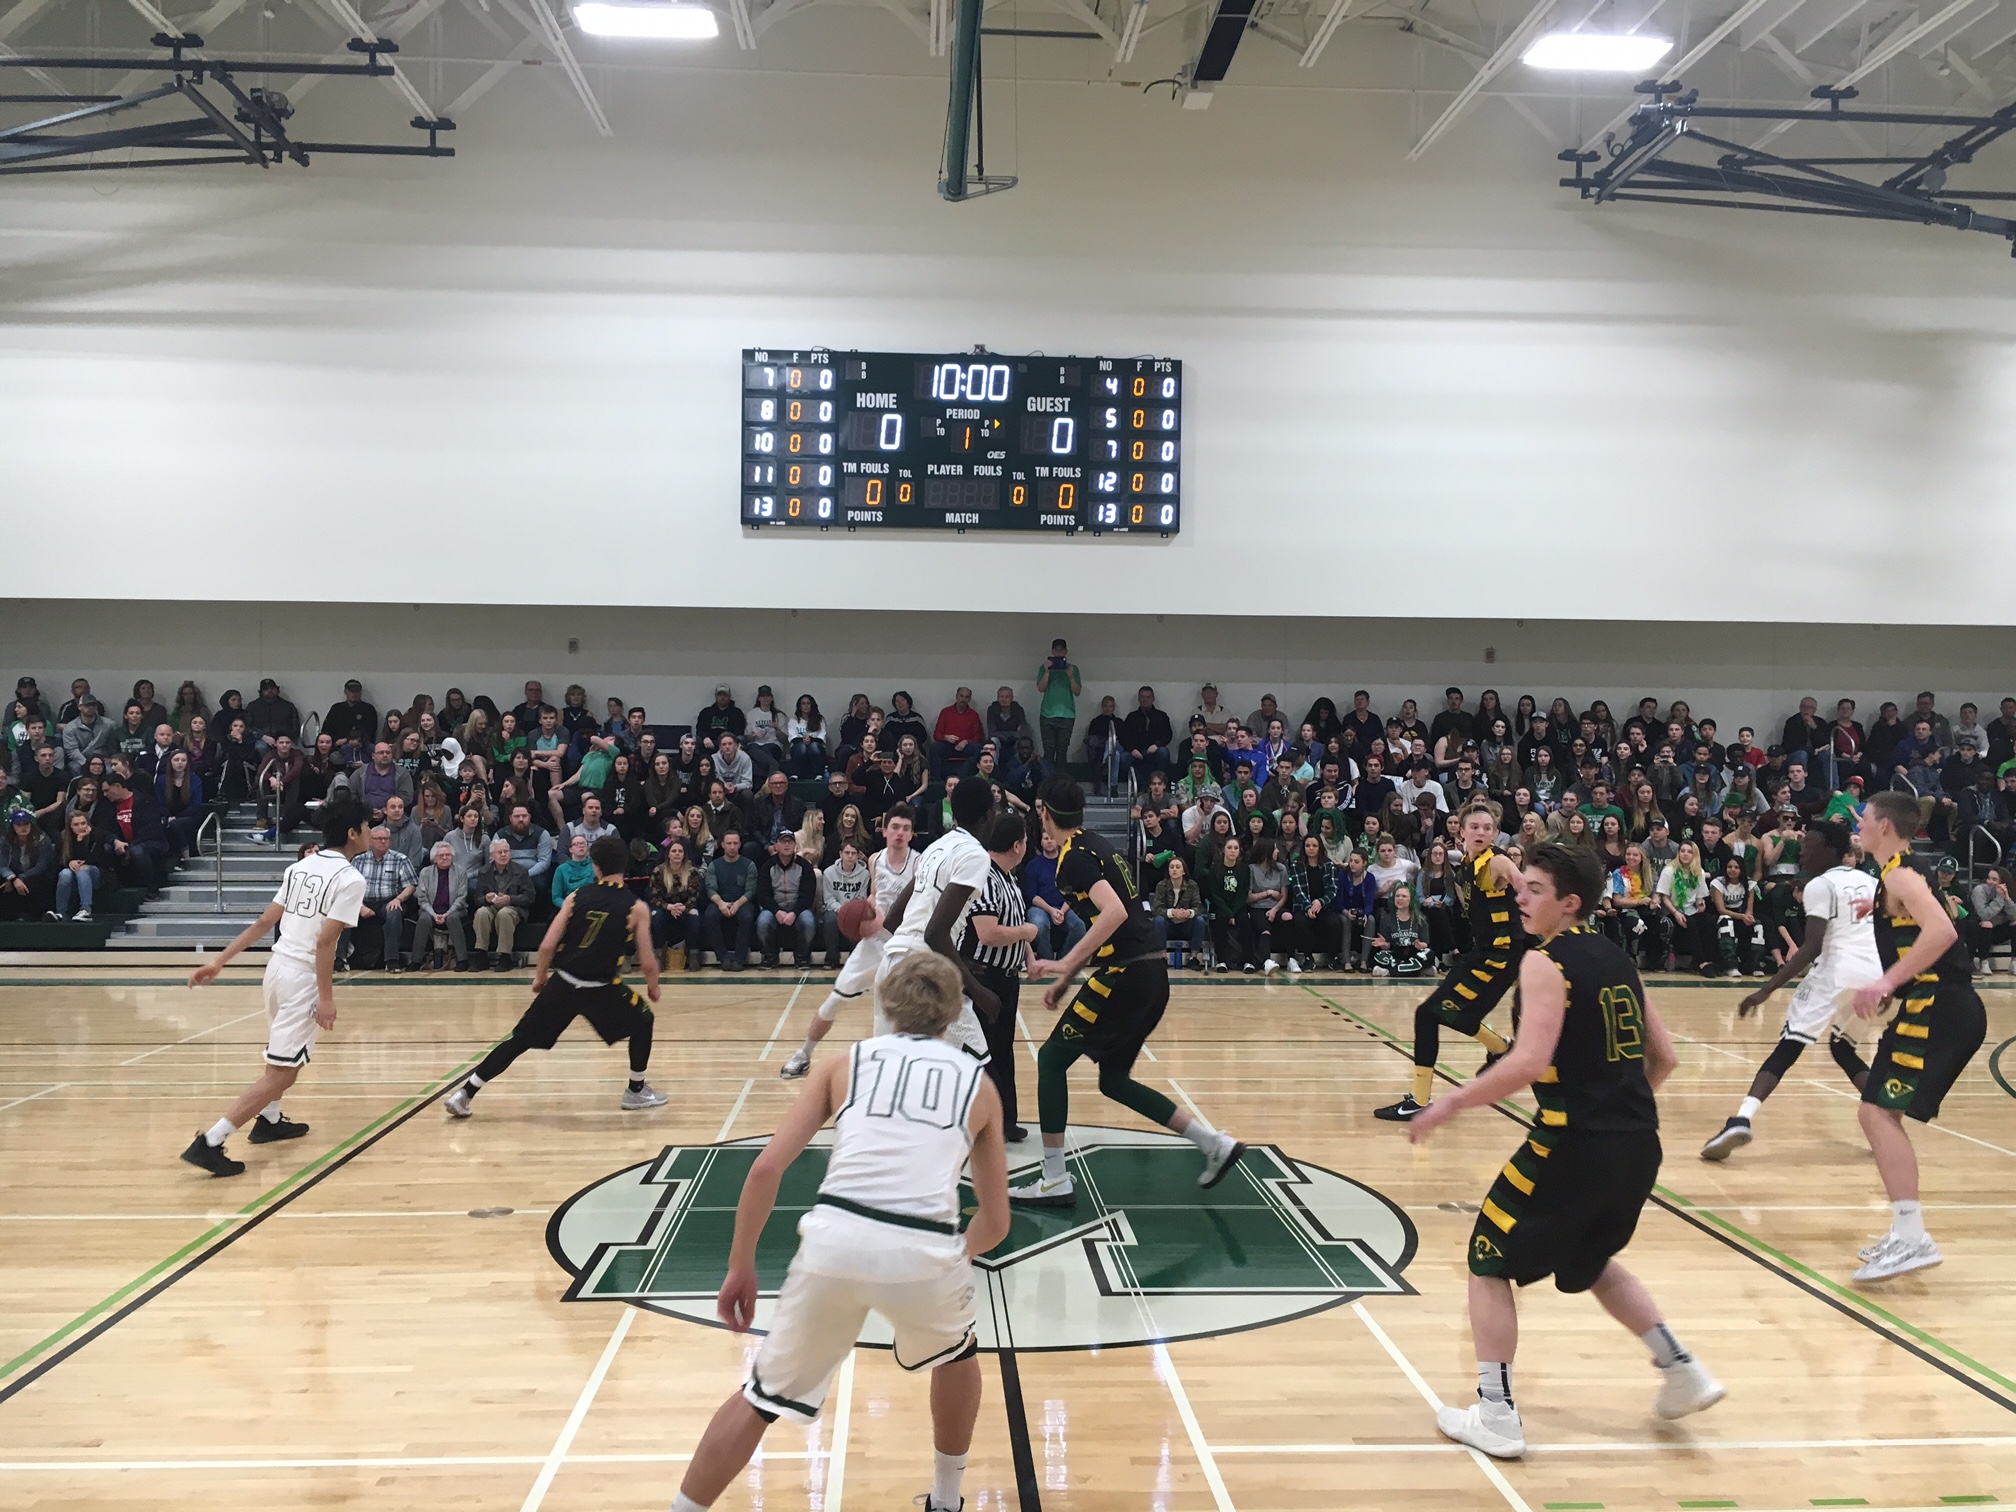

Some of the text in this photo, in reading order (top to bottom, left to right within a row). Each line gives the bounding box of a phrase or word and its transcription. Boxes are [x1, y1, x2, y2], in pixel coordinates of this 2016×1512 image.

[755, 352, 829, 364] NO F PTS
[862, 362, 866, 370] B
[1100, 361, 1172, 372] NO F PTS
[764, 368, 832, 389] 7 0 0
[862, 371, 866, 379] B
[1060, 367, 1065, 375] B
[1060, 376, 1065, 384] B
[932, 364, 1010, 401] 10:00
[1106, 378, 1175, 397] 4 0 0
[856, 393, 897, 408] HOME
[1027, 397, 1070, 412] GUEST
[761, 400, 832, 421] 8 0 0
[946, 409, 980, 420] PERIOD
[1106, 408, 1174, 429] 5 0 0
[880, 414, 902, 450] 0
[936, 428, 945, 436] TO
[981, 428, 990, 437] TO
[984, 420, 990, 428] P
[755, 432, 832, 454] 10 0 0
[965, 427, 970, 449] 1
[1052, 418, 1074, 454] 0
[1107, 440, 1174, 461] 7 0 0
[755, 466, 832, 486] 11 0 0
[843, 463, 890, 474] TM FOULS
[899, 470, 912, 478] TOL
[928, 464, 1002, 476] PLAYER FOULS
[1012, 472, 1025, 480] TOL
[1035, 467, 1081, 478] TM FOULS
[1098, 472, 1174, 493] 12 0 0
[866, 480, 882, 505] 0
[899, 484, 911, 502] 0
[1013, 486, 1024, 505] 0
[1058, 484, 1074, 509] 0
[754, 497, 831, 518] 13 0 0
[848, 511, 883, 522] POINTS
[1098, 503, 1174, 525] 13 0 0
[946, 513, 979, 524] MATCH
[1040, 515, 1075, 526] POINTS
[285, 871, 323, 918] 13
[578, 910, 609, 948] 7
[1598, 984, 1644, 1062] 13
[866, 1048, 962, 1130] 10
